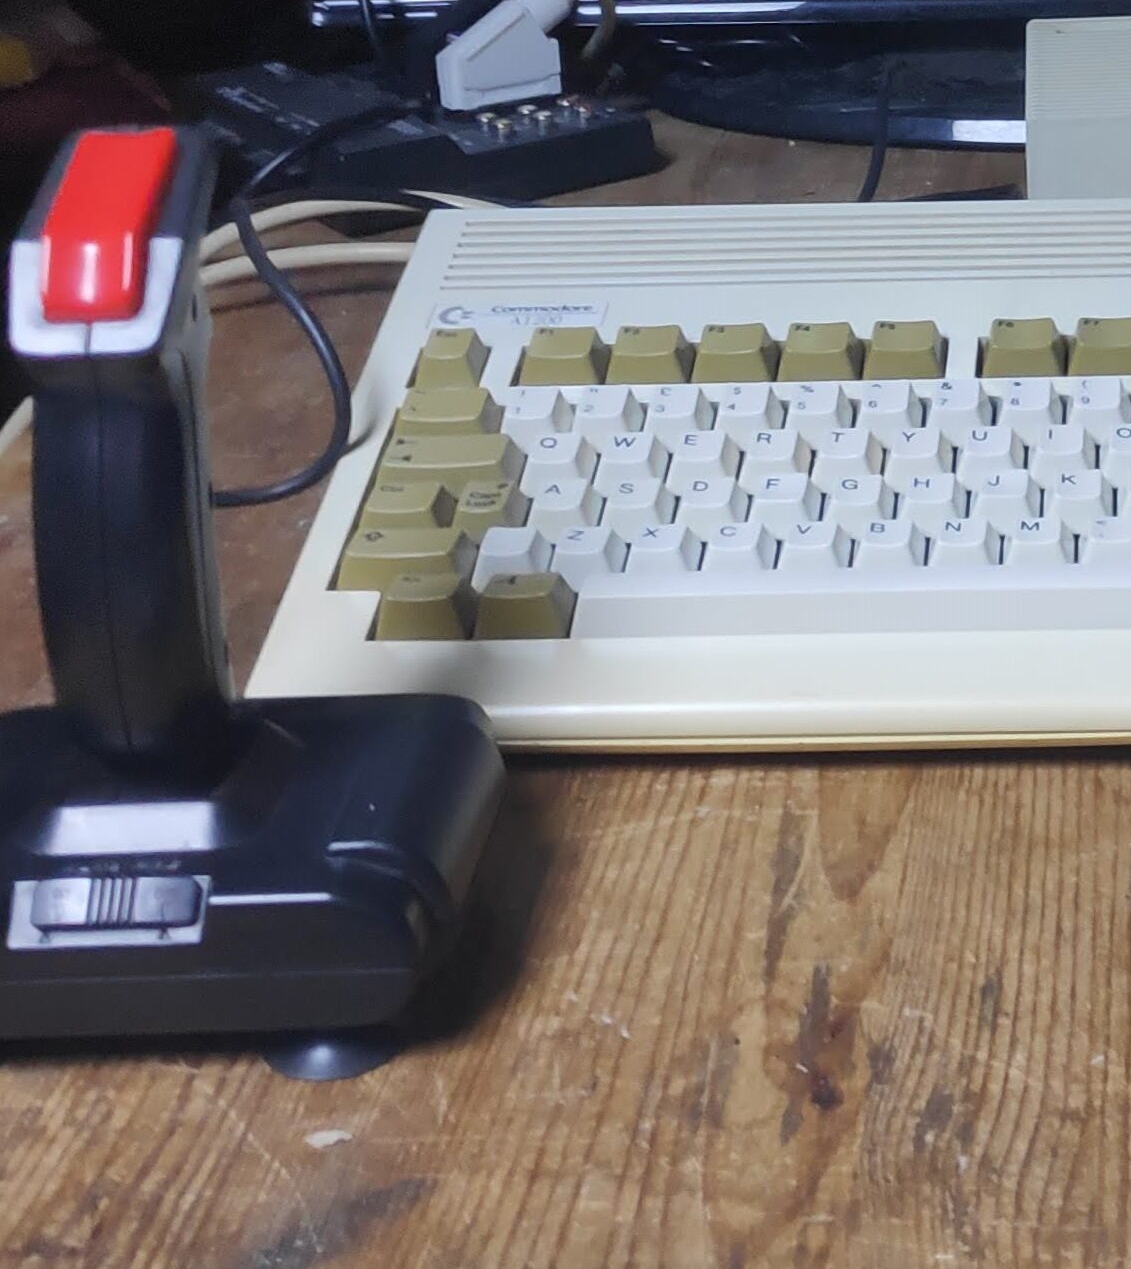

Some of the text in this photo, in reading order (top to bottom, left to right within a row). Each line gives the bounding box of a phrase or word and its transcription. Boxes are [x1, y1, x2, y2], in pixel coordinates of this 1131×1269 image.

[491, 304, 593, 313] Commodore
[684, 433, 700, 447] E
[756, 432, 772, 444] R
[831, 431, 845, 443] T
[902, 431, 916, 442] Y
[971, 430, 988, 442] U
[613, 436, 636, 448] W
[765, 478, 780, 490] F
[841, 479, 859, 490] G
[913, 477, 930, 489] H
[987, 475, 1000, 487] J
[1061, 473, 1076, 485] K
[544, 484, 561, 495] A
[618, 483, 634, 494] S
[692, 480, 709, 492] D
[796, 524, 812, 535] V
[870, 522, 885, 533] B
[945, 521, 962, 532] N
[1020, 520, 1040, 531] M
[567, 530, 585, 541] Z
[643, 527, 658, 538] X
[719, 526, 737, 537] C
